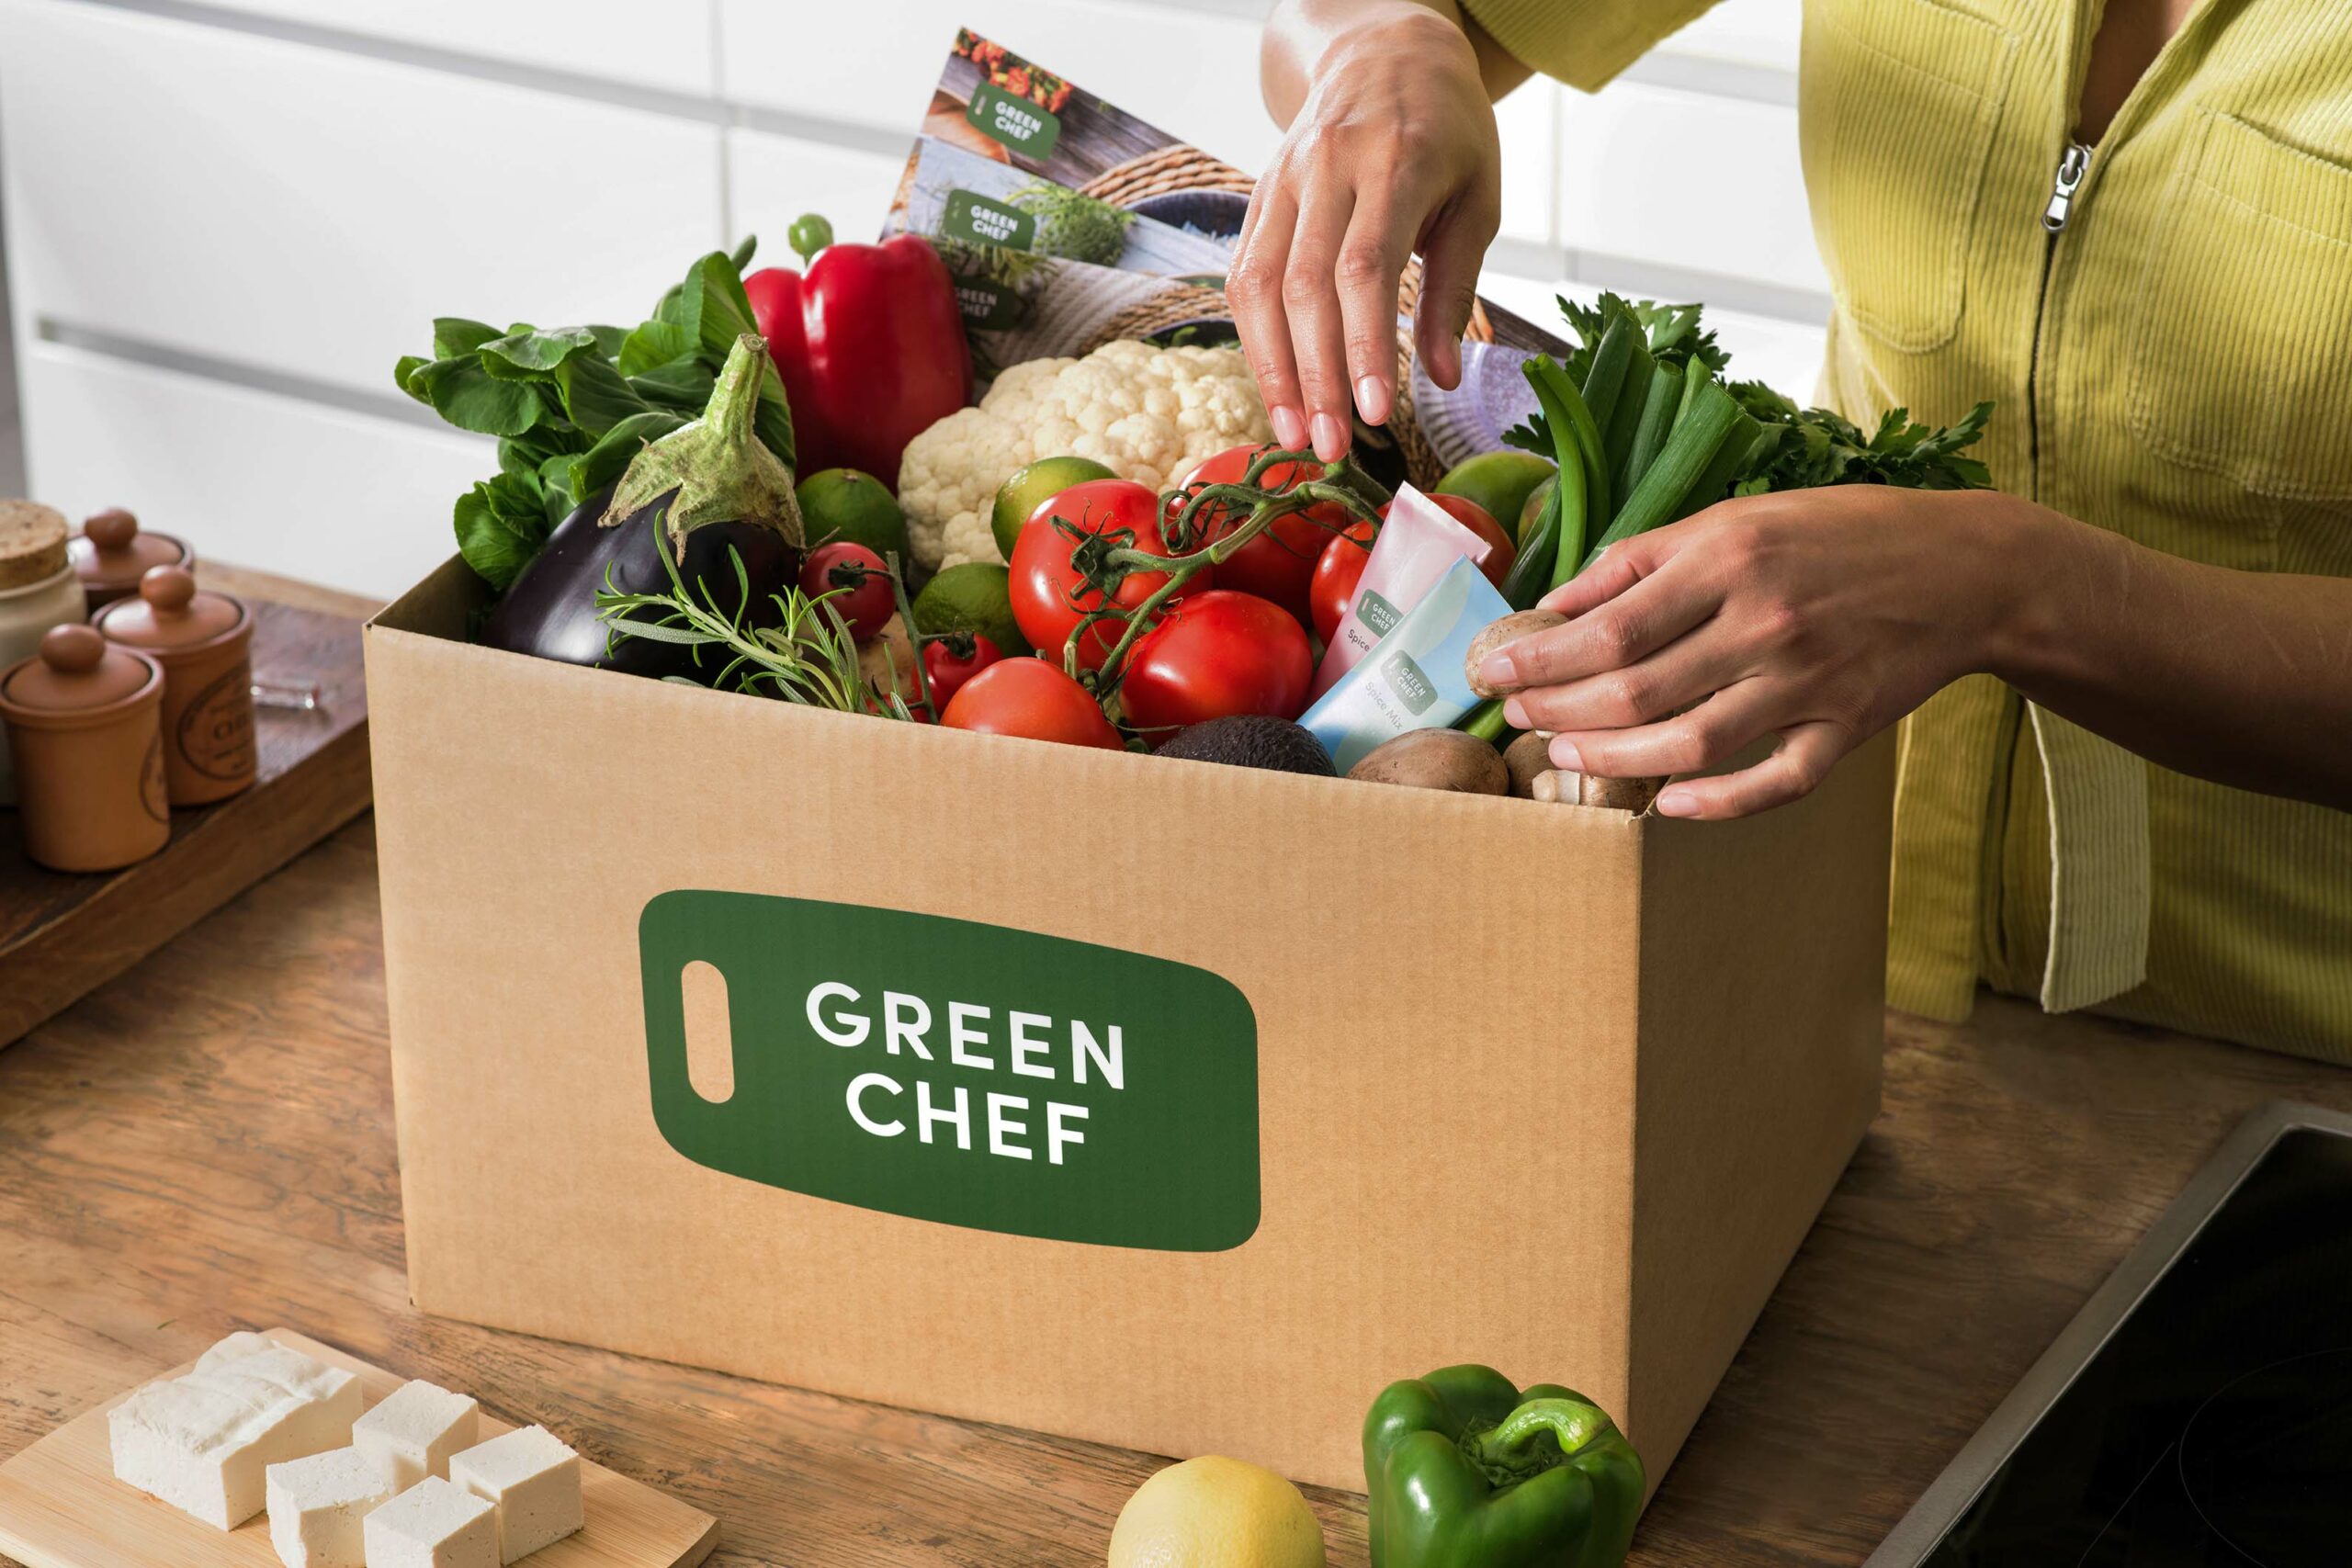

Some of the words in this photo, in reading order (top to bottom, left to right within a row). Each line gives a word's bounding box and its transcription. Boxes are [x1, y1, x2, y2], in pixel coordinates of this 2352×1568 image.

[995, 101, 1042, 133] GREEN
[995, 116, 1033, 141] CHEF
[970, 205, 1018, 232] GREEN
[972, 220, 1010, 241] CHEF
[1371, 614, 1389, 630] CHEF
[1373, 604, 1396, 626] GREEN
[1348, 629, 1370, 651] Spice
[1396, 677, 1417, 698] CHEF
[1401, 668, 1426, 696] GREEN
[1365, 682, 1386, 710] Spice
[1385, 709, 1403, 730] Mix
[806, 981, 1125, 1089] GREEN
[845, 1072, 1090, 1165] CHEF
